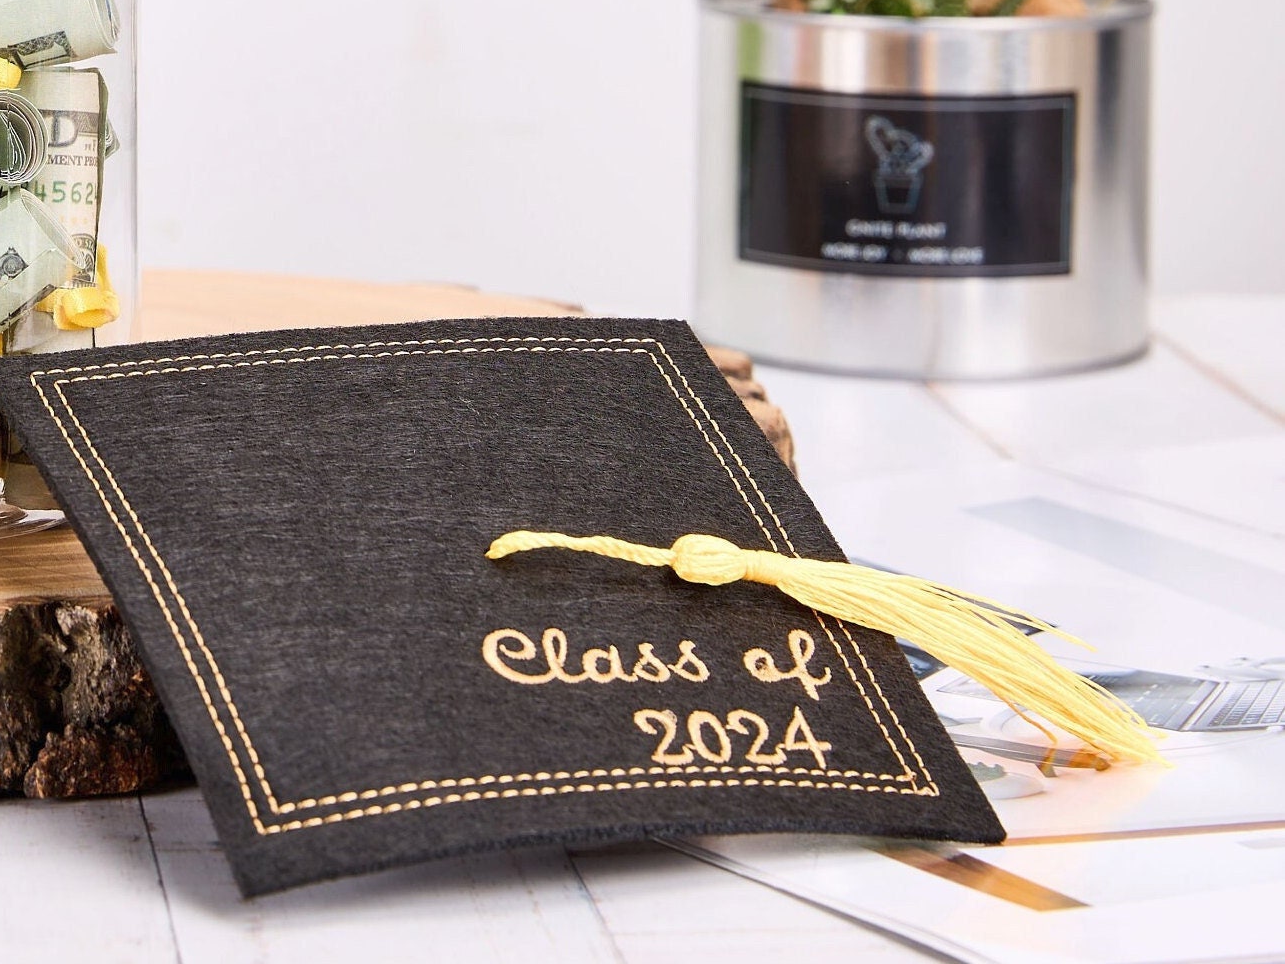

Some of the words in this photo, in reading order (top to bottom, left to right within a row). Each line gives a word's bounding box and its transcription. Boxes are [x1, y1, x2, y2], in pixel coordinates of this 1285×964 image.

[33, 180, 97, 205] 4562
[482, 628, 710, 684] Class
[742, 629, 832, 701] of
[633, 706, 832, 769] 2024
